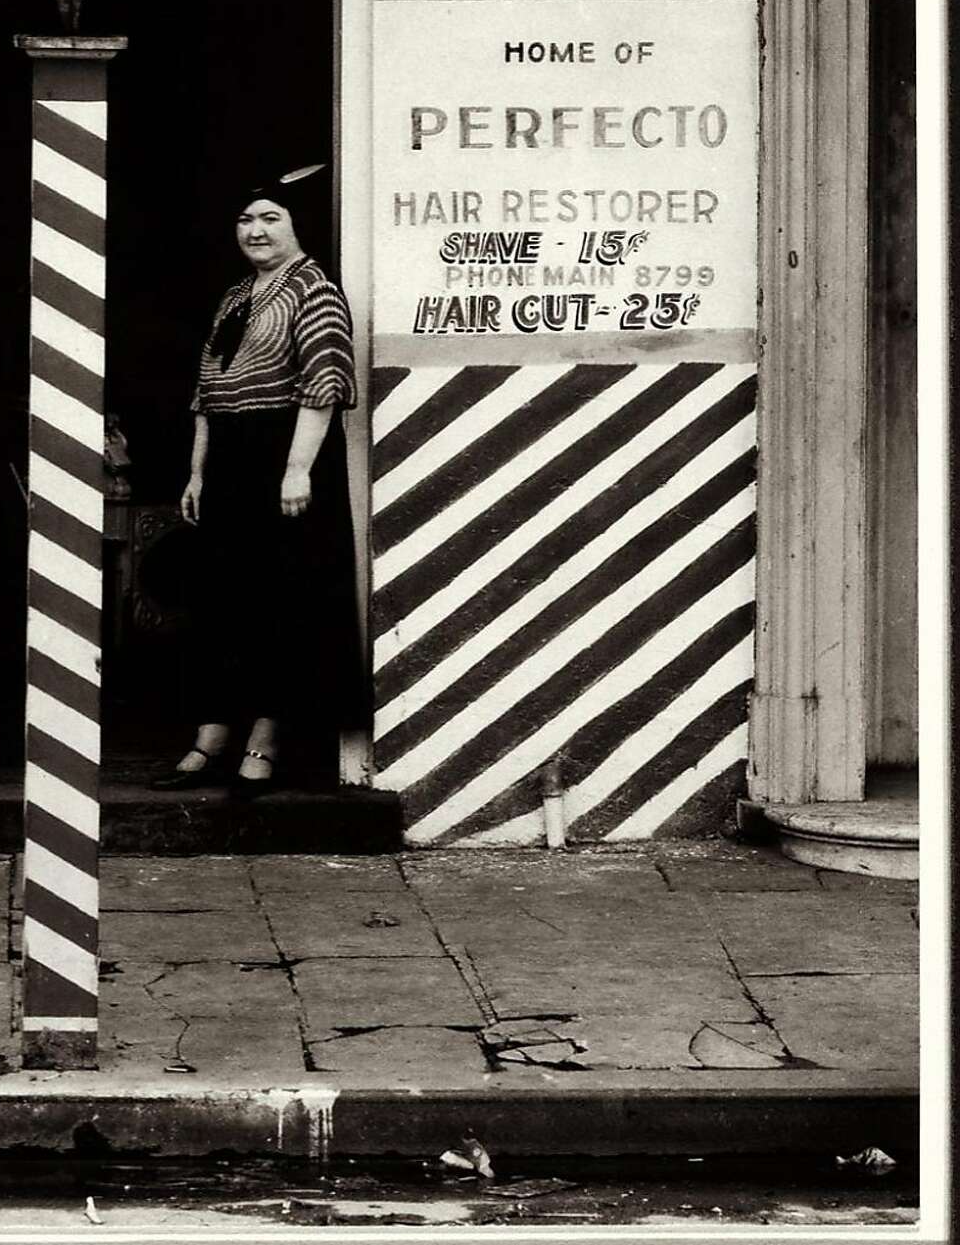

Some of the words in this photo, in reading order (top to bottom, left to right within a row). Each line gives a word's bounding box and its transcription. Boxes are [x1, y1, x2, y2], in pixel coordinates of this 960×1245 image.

[504, 42, 595, 63] HOME
[615, 42, 655, 64] OF
[410, 104, 728, 150] PERFECTO
[393, 190, 483, 226] HAIR
[502, 190, 719, 223] RESTORER
[440, 231, 542, 264] SHAVE
[578, 230, 650, 265] 15¢
[445, 266, 536, 288] PHONE
[543, 266, 615, 287] MAIN
[635, 265, 716, 287] 8799
[413, 294, 502, 333] HAIR
[619, 293, 701, 331] 25¢
